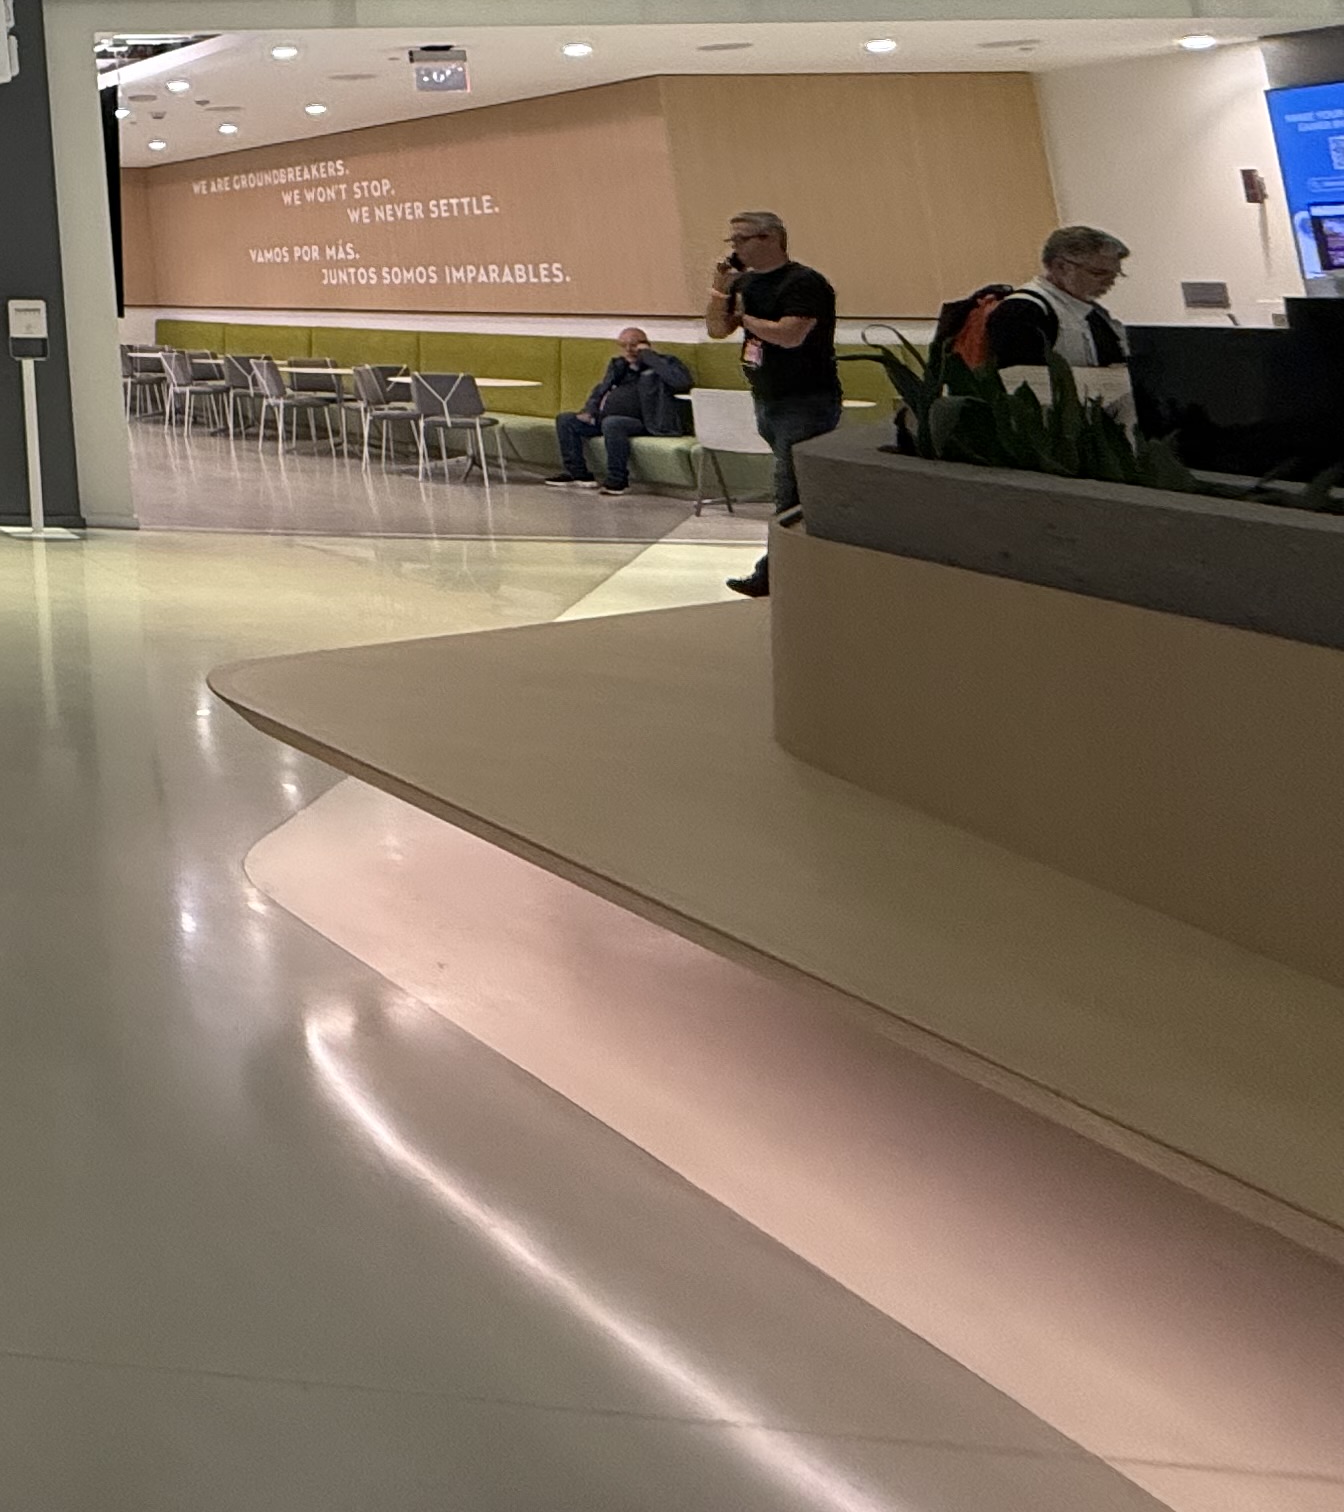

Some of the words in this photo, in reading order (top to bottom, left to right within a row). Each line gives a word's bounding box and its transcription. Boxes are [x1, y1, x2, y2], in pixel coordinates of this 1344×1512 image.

[192, 180, 208, 195] WE
[210, 176, 230, 193] ARE
[233, 159, 350, 190] GROUNDBREAKERS.
[281, 189, 302, 206] WE
[304, 183, 347, 203] WON'T
[353, 179, 396, 199] STOP.
[346, 206, 371, 224] WE
[374, 201, 424, 222] NEVER
[428, 194, 500, 218] SETTLE.
[249, 246, 289, 263] VAMOS
[293, 245, 320, 261] POR
[325, 239, 360, 261] MÁS.
[321, 267, 378, 285] JUNTOS
[381, 265, 438, 285] SOMOS
[444, 262, 571, 284] IMPARABLES.
